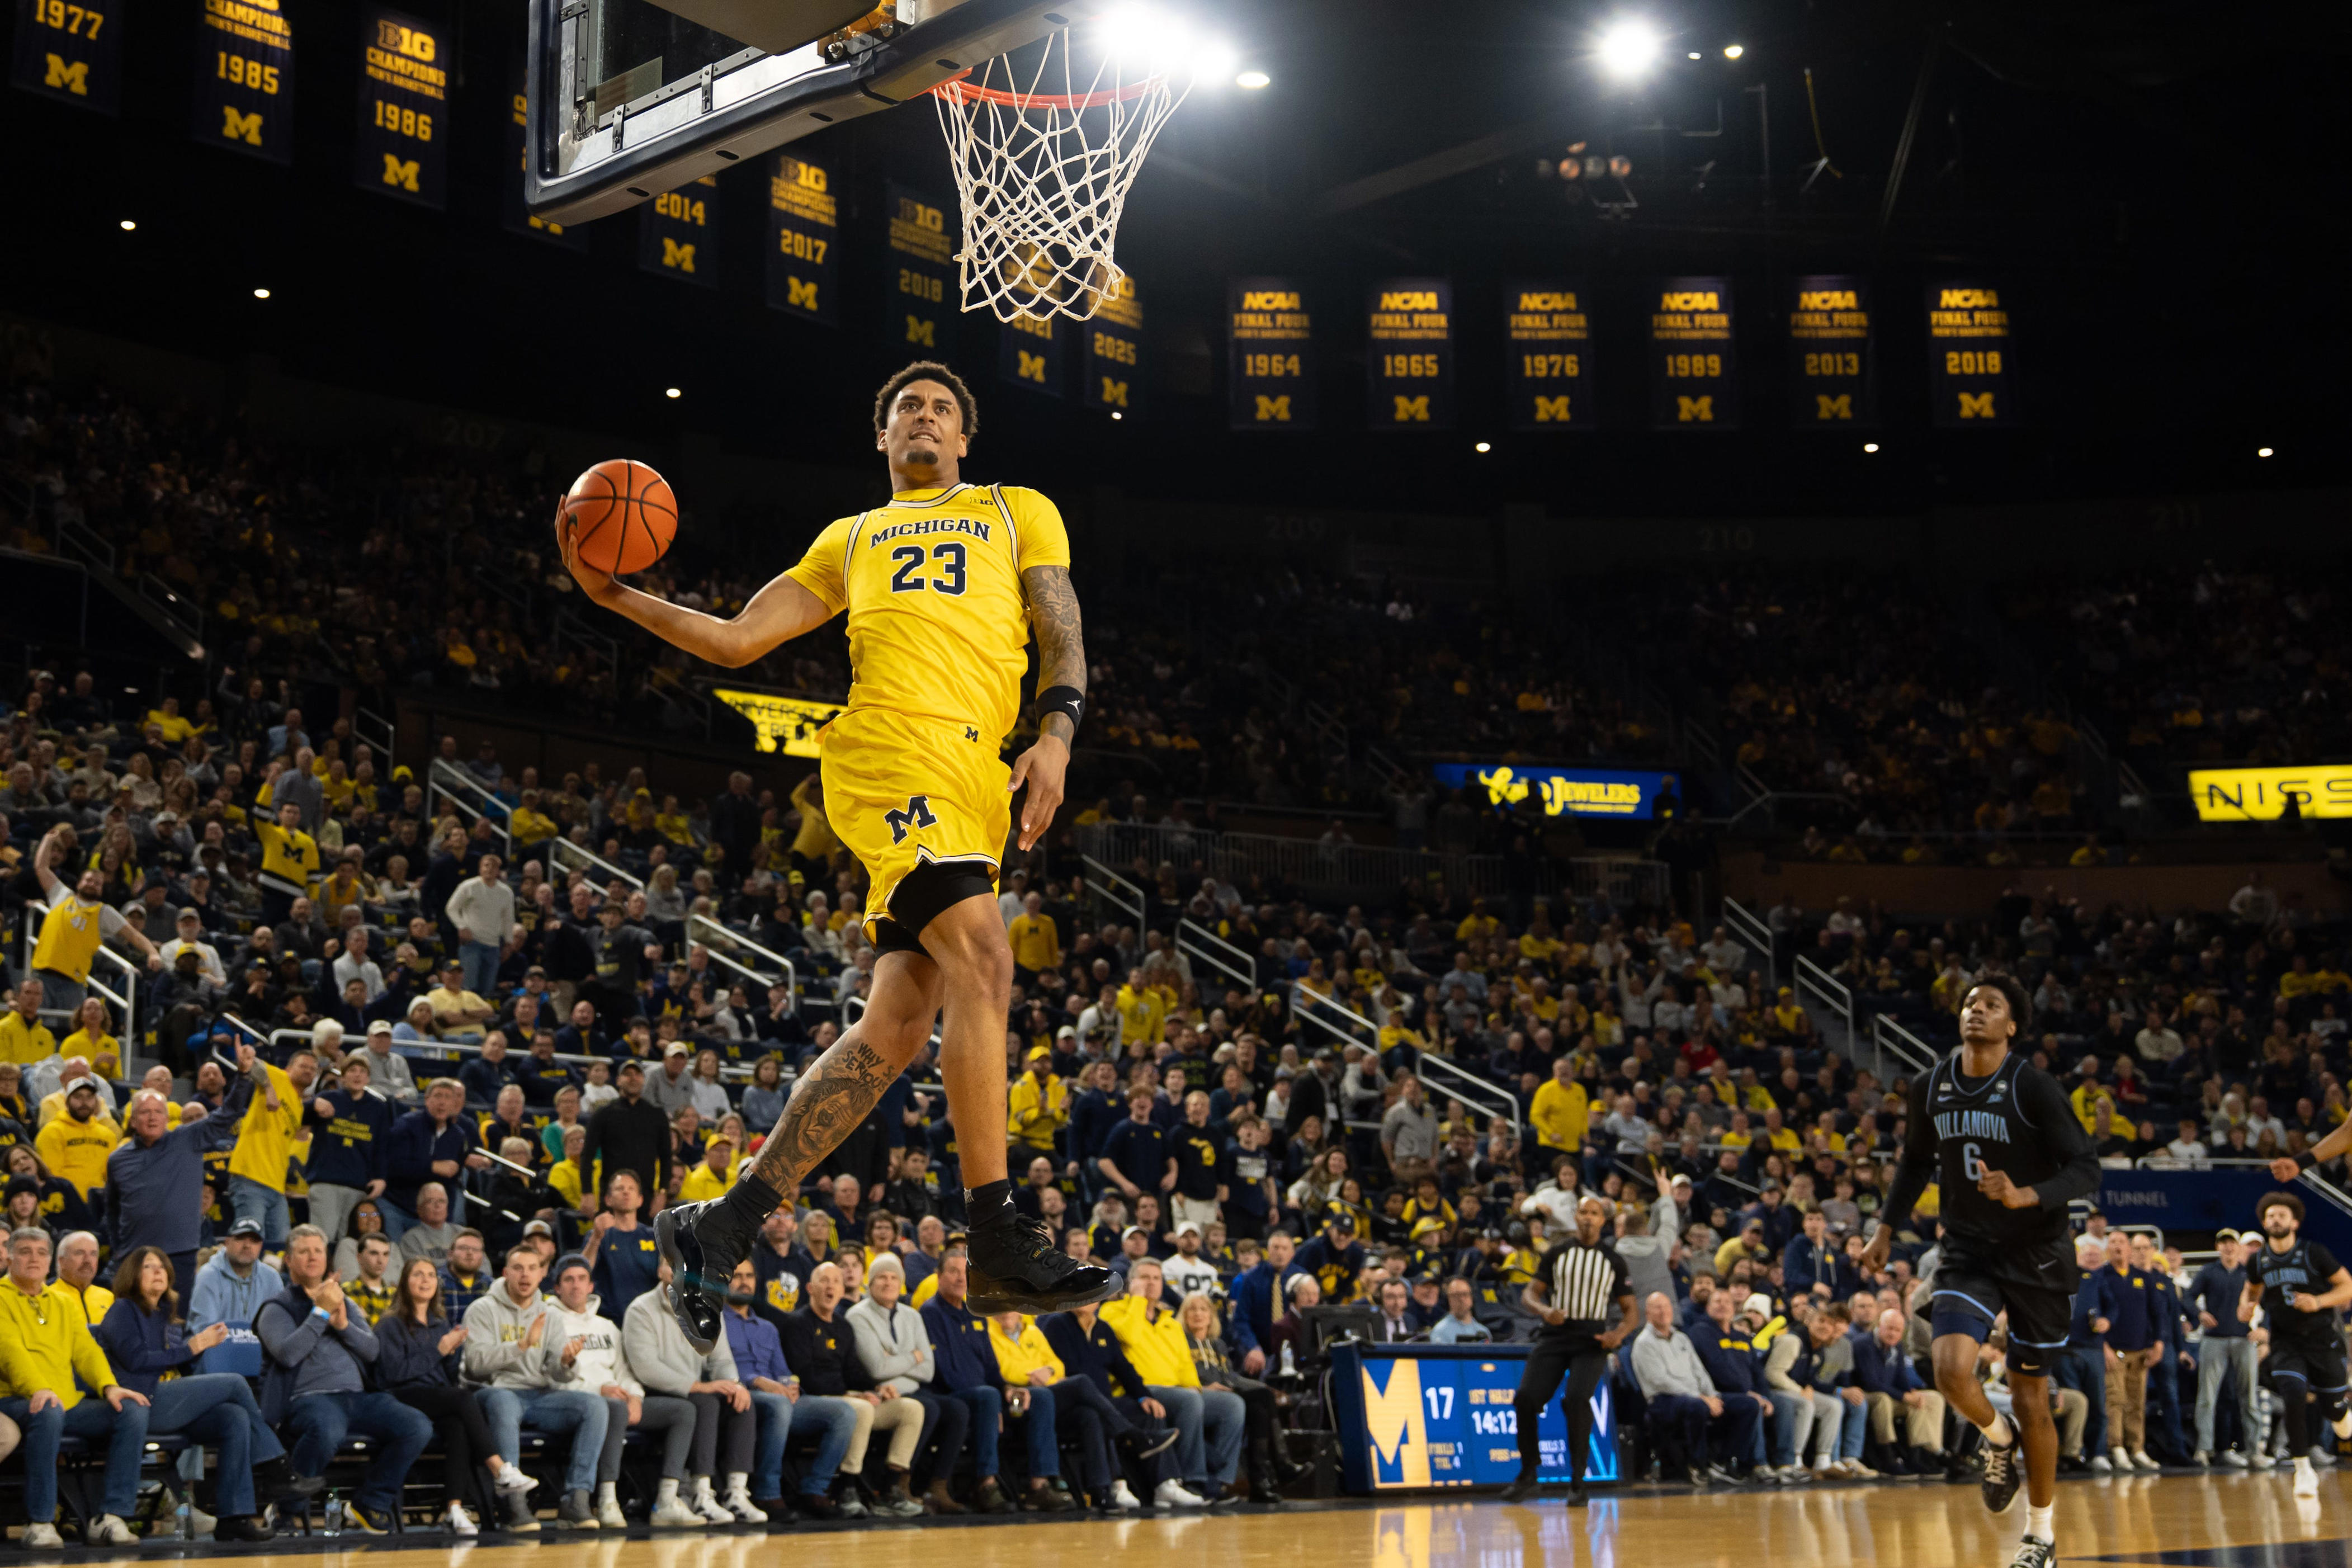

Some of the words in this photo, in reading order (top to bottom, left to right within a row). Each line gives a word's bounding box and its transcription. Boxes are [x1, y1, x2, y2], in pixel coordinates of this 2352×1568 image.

[36, 0, 103, 40] 1977
[45, 53, 88, 95] M
[219, 52, 278, 95] 1985
[366, 46, 446, 88] CHAMPIONS
[223, 106, 262, 145] M
[375, 100, 432, 141] 1986
[383, 153, 419, 192] M
[655, 193, 705, 225] 2014
[663, 237, 695, 272] M
[781, 229, 827, 264] 2017
[788, 276, 818, 311] M
[1244, 292, 1300, 310] NCAA
[1380, 292, 1438, 311] NCAA
[1519, 293, 1576, 311] NCAA
[1661, 292, 1719, 311] NCAA
[1799, 290, 1858, 310] NCAA
[1940, 289, 1998, 308] NCAA
[1018, 350, 1046, 383] M
[1246, 355, 1300, 377] 1964
[1385, 355, 1438, 377] 1965
[1524, 355, 1579, 377] 1976
[1667, 355, 1721, 377] 1989
[1805, 353, 1858, 375] 2013
[1945, 351, 2002, 374] 2018
[1102, 376, 1128, 408] M
[1255, 395, 1291, 421] M
[1394, 395, 1429, 421] M
[1534, 395, 1570, 421] M
[1677, 395, 1713, 421] M
[1817, 394, 1852, 419] M
[1958, 393, 1995, 418] M
[870, 519, 990, 550] MICHIGAN
[891, 541, 966, 597] 23
[965, 725, 979, 743] M
[884, 795, 938, 846] M
[284, 843, 304, 864] M
[857, 1042, 885, 1069] WHY
[1933, 1110, 2011, 1144] VILLANOVA
[1963, 1142, 1983, 1182] 6
[1425, 1386, 1454, 1420] 17
[1471, 1410, 1518, 1435] 14:12
